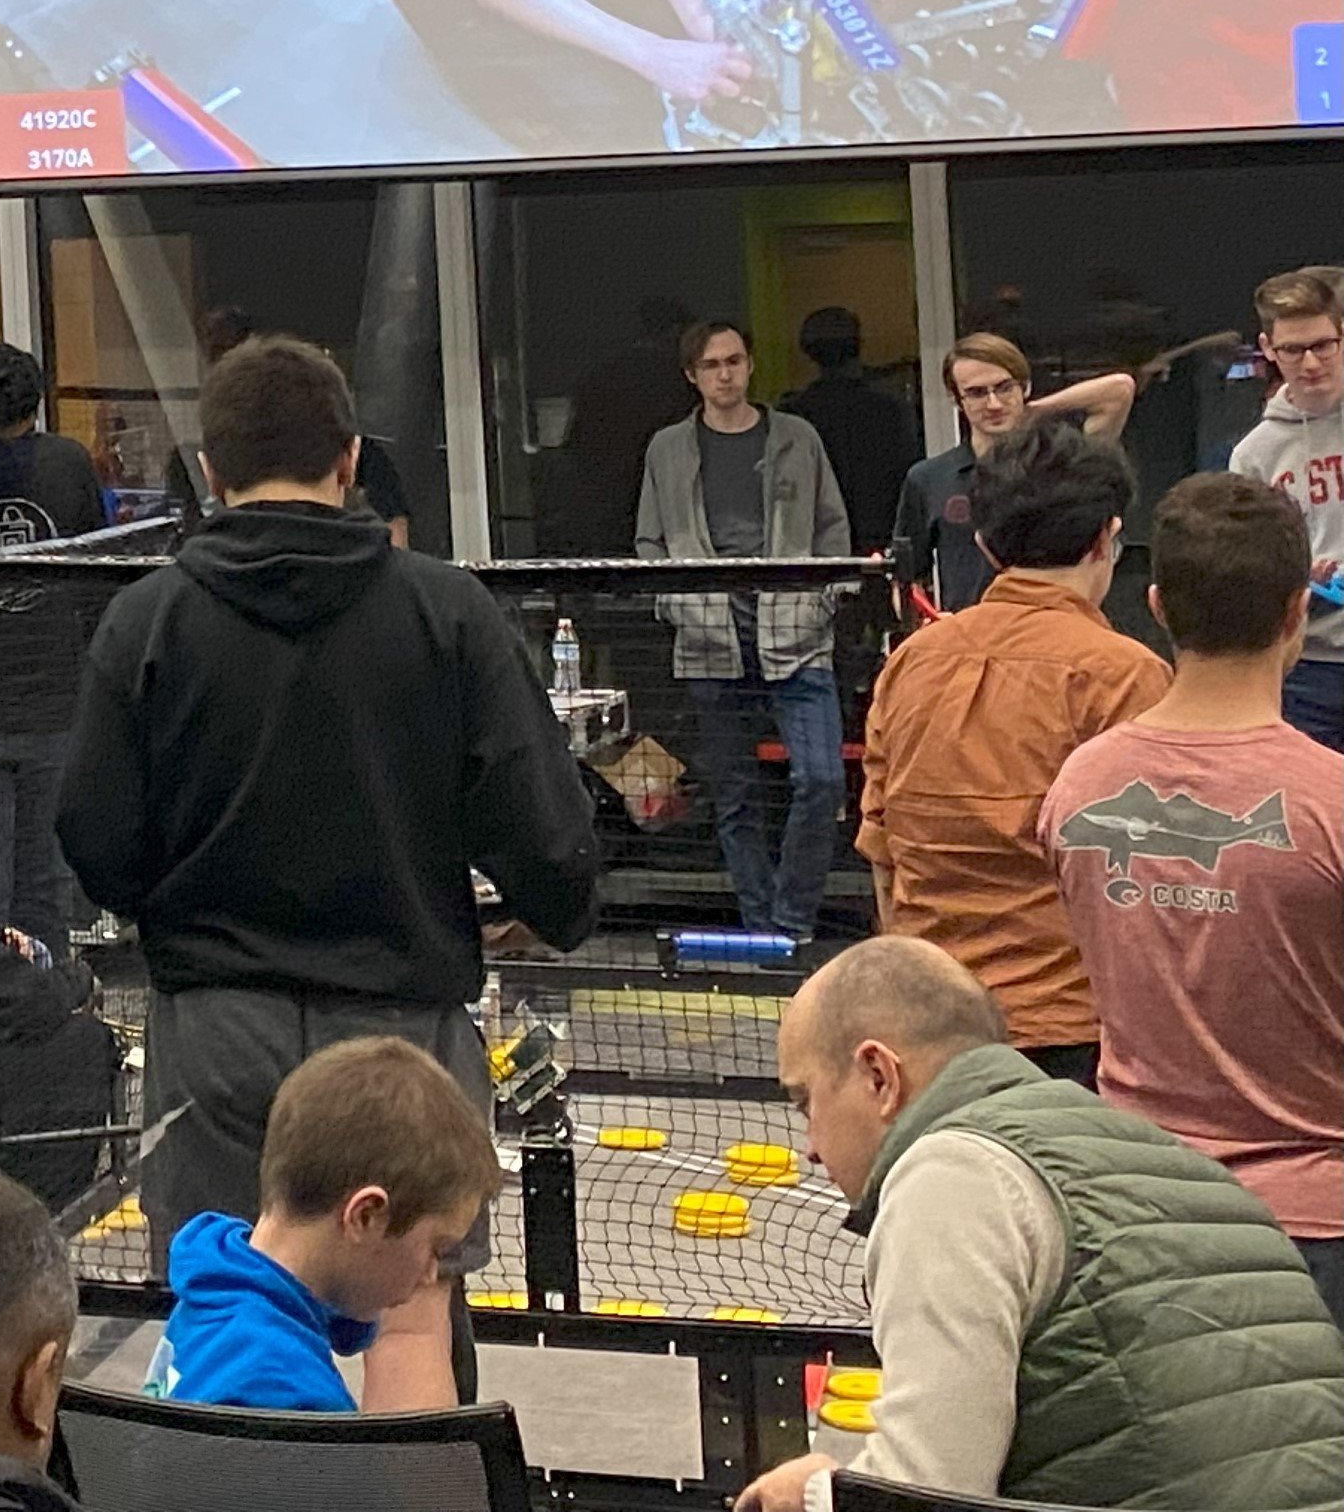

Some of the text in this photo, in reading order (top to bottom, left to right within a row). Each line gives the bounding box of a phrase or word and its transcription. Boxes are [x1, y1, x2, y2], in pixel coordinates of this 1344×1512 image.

[1315, 47, 1328, 66] 2
[1320, 91, 1330, 109] 1
[20, 108, 97, 131] 41920C
[28, 147, 94, 170] 3170A
[1151, 884, 1238, 913] COSTA
